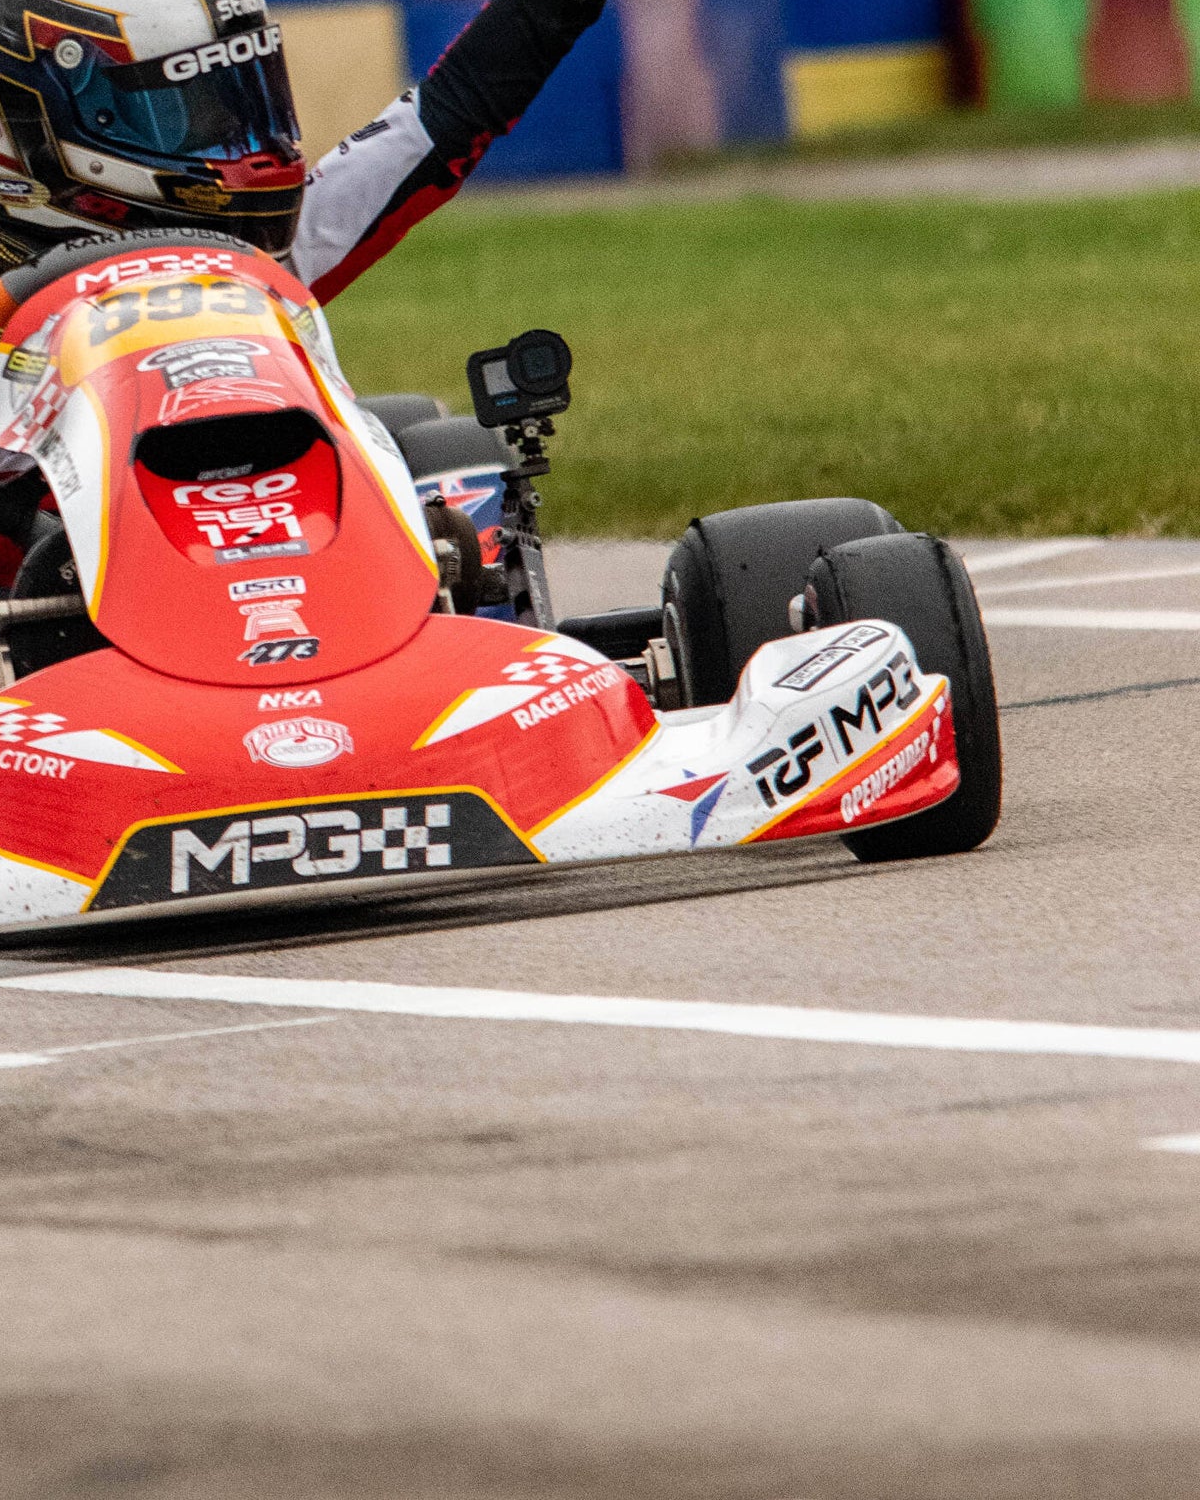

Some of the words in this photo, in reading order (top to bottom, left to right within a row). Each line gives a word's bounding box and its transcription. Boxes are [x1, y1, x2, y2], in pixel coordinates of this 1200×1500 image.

[162, 26, 282, 82] GROUP
[88, 280, 267, 347] 893
[172, 472, 298, 505] rep
[192, 501, 294, 523] RED
[258, 689, 323, 710] NKA
[510, 690, 571, 731] RACE
[562, 664, 625, 705] FACTORY
[170, 809, 362, 895] MPG
